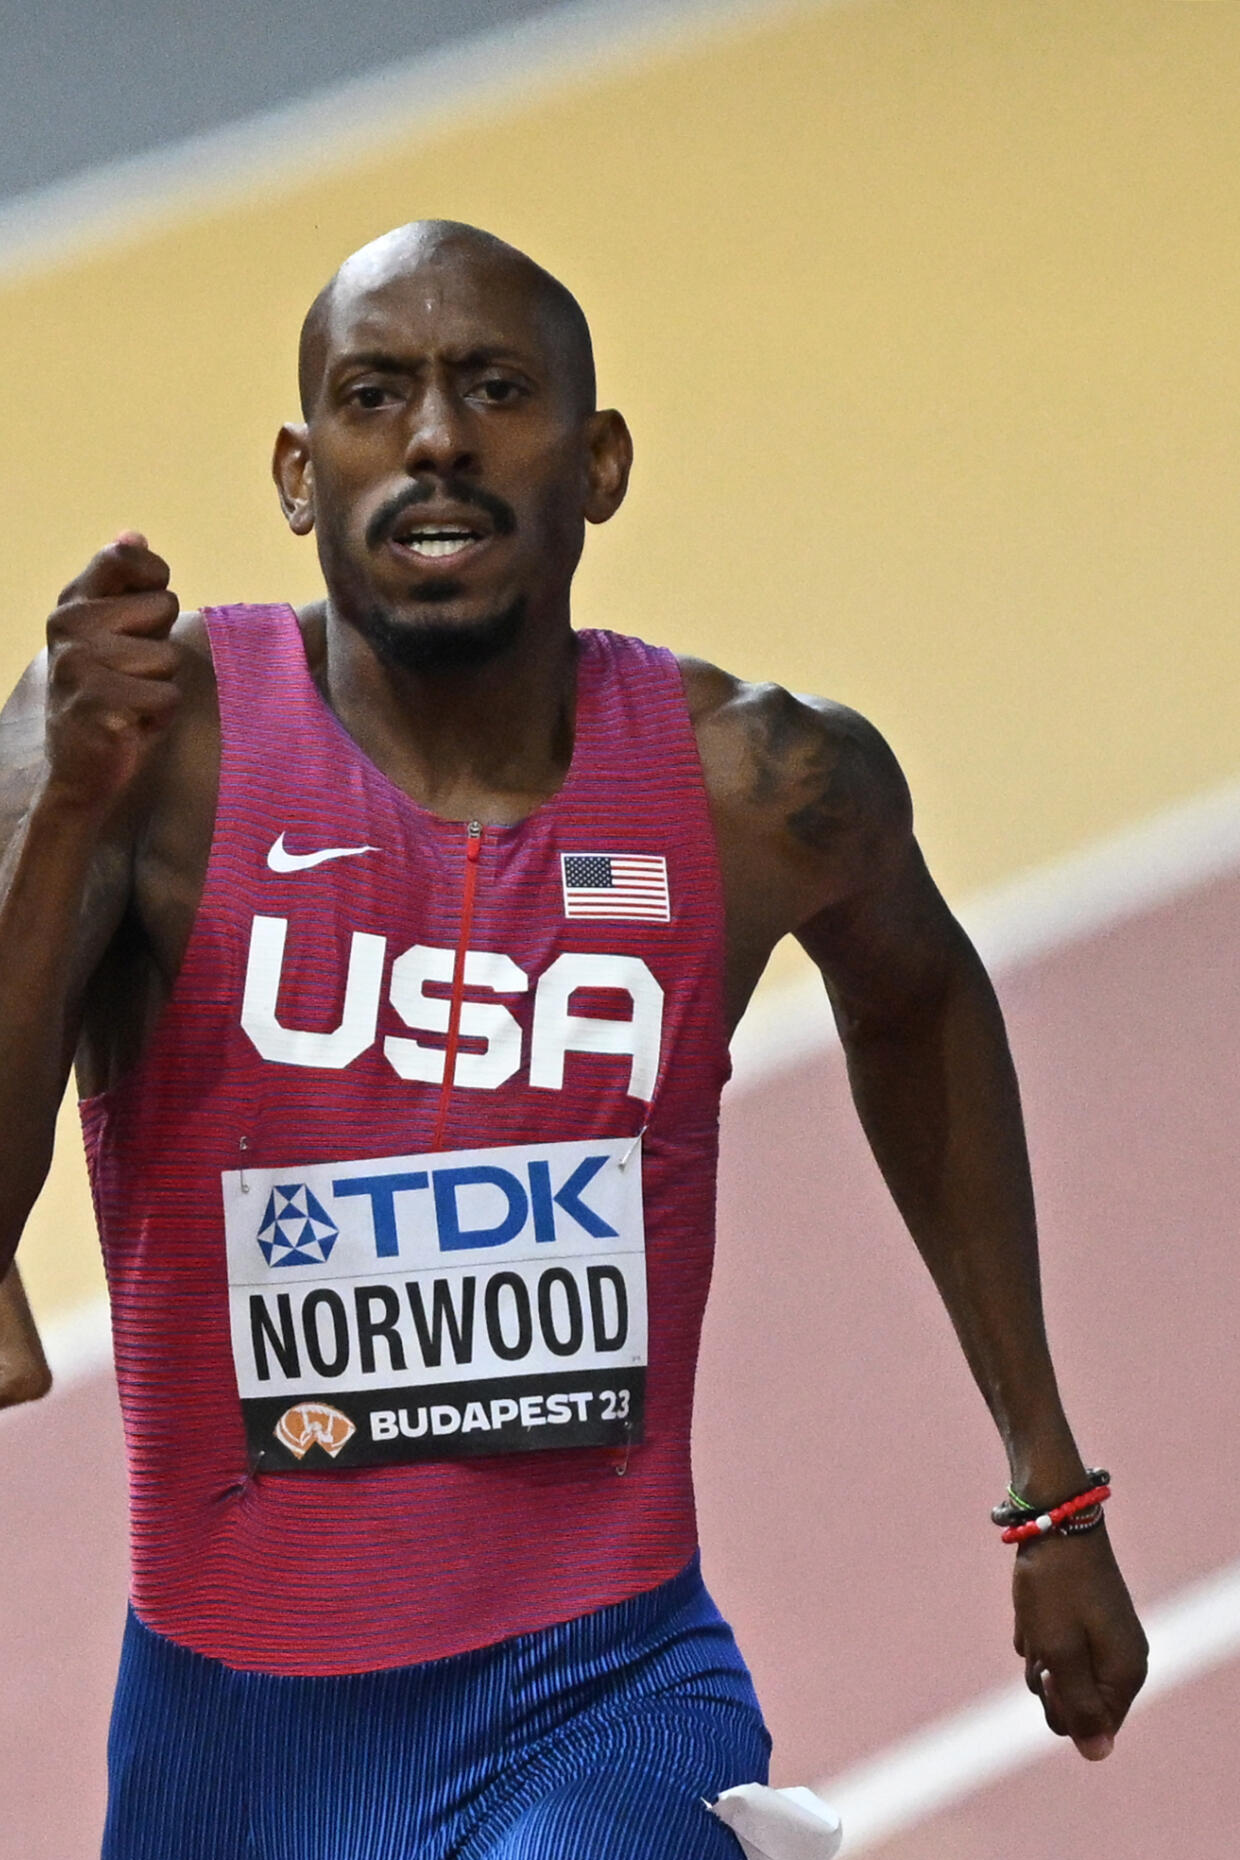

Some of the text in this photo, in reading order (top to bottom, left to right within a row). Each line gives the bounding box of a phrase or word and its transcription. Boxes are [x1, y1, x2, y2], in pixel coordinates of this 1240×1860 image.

[241, 915, 664, 1102] USA
[332, 1155, 620, 1258] TDK
[248, 1264, 629, 1382] NORWOOD
[369, 1389, 630, 1442] BUDAPEST 23
